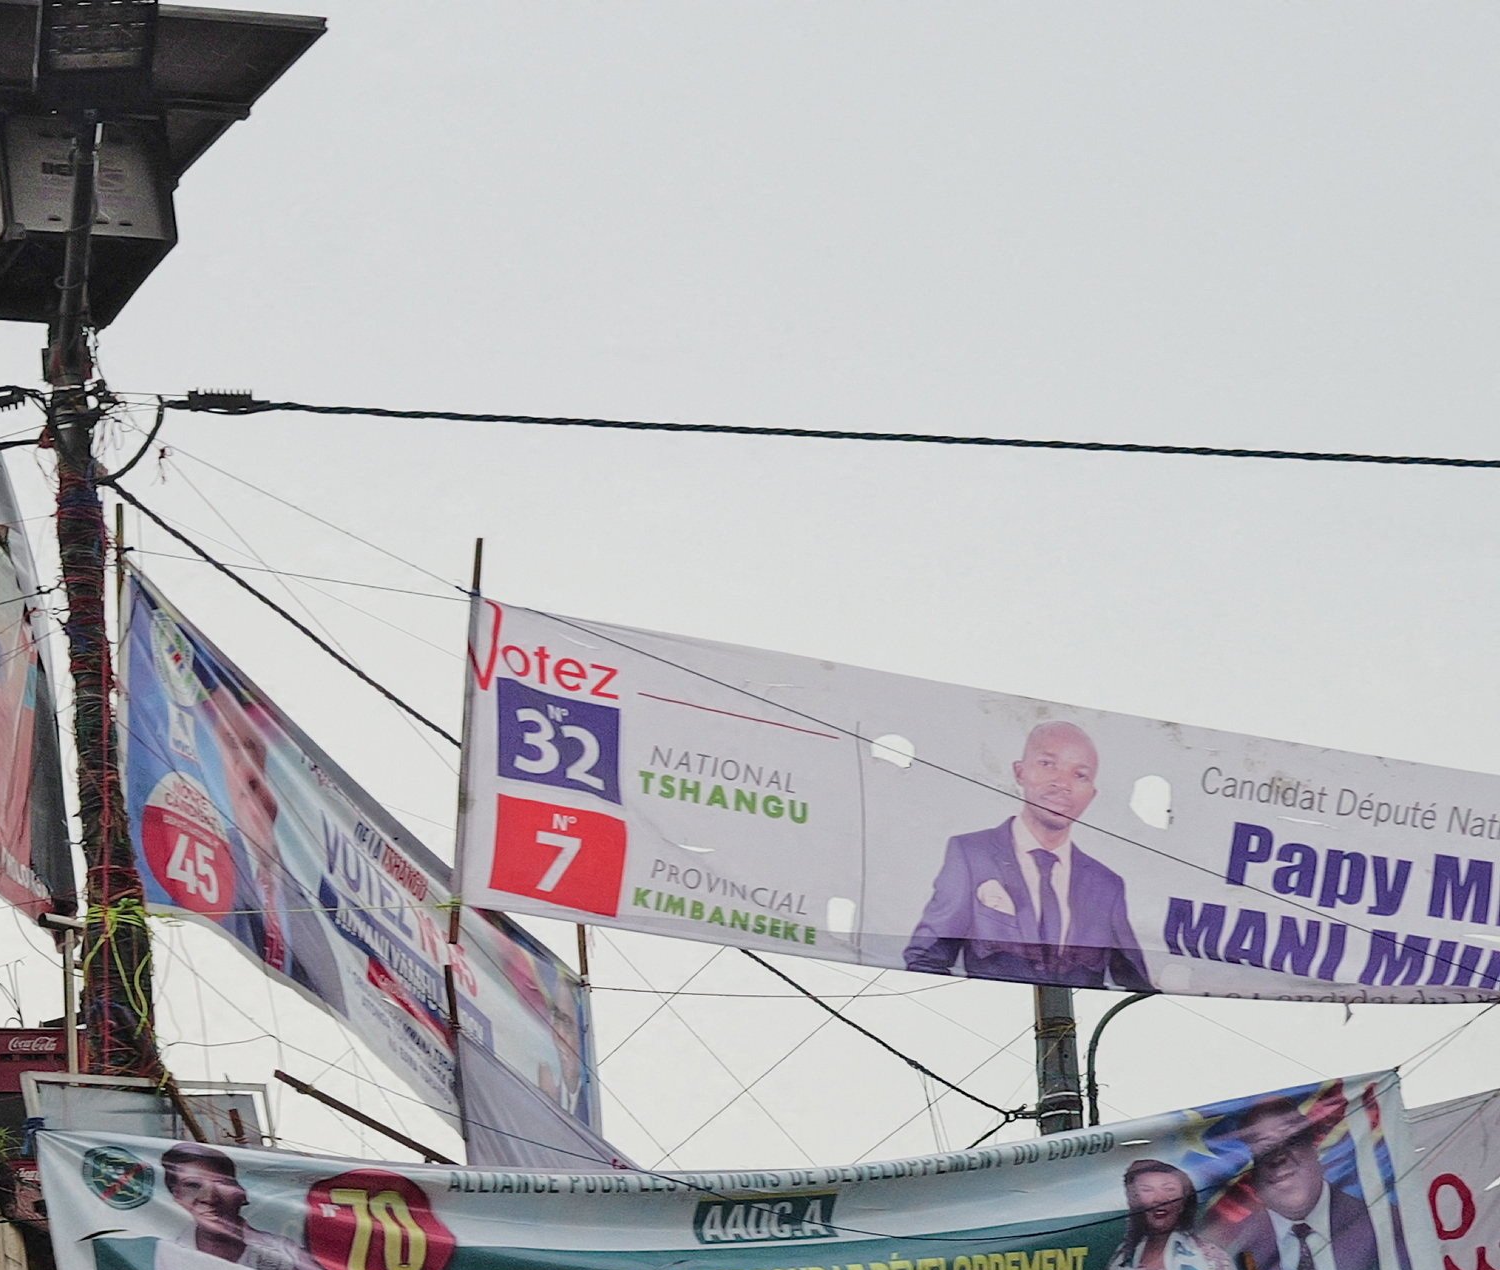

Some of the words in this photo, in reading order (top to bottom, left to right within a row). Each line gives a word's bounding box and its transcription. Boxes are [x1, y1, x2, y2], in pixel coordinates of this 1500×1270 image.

[468, 601, 619, 699] Votez
[514, 707, 605, 792] 32
[650, 746, 796, 794] NATIONAL
[639, 770, 809, 825] TSHANGU
[1201, 767, 1327, 814] Candidat
[1336, 788, 1436, 829] Député
[167, 835, 217, 904] 45
[535, 831, 582, 892] 7
[650, 857, 808, 914] PROVINCIAL
[1226, 822, 1413, 917] Papy
[633, 888, 817, 944] KIMBANSEKE
[1164, 897, 1347, 981] MANI
[1047, 1131, 1116, 1156] CONGO
